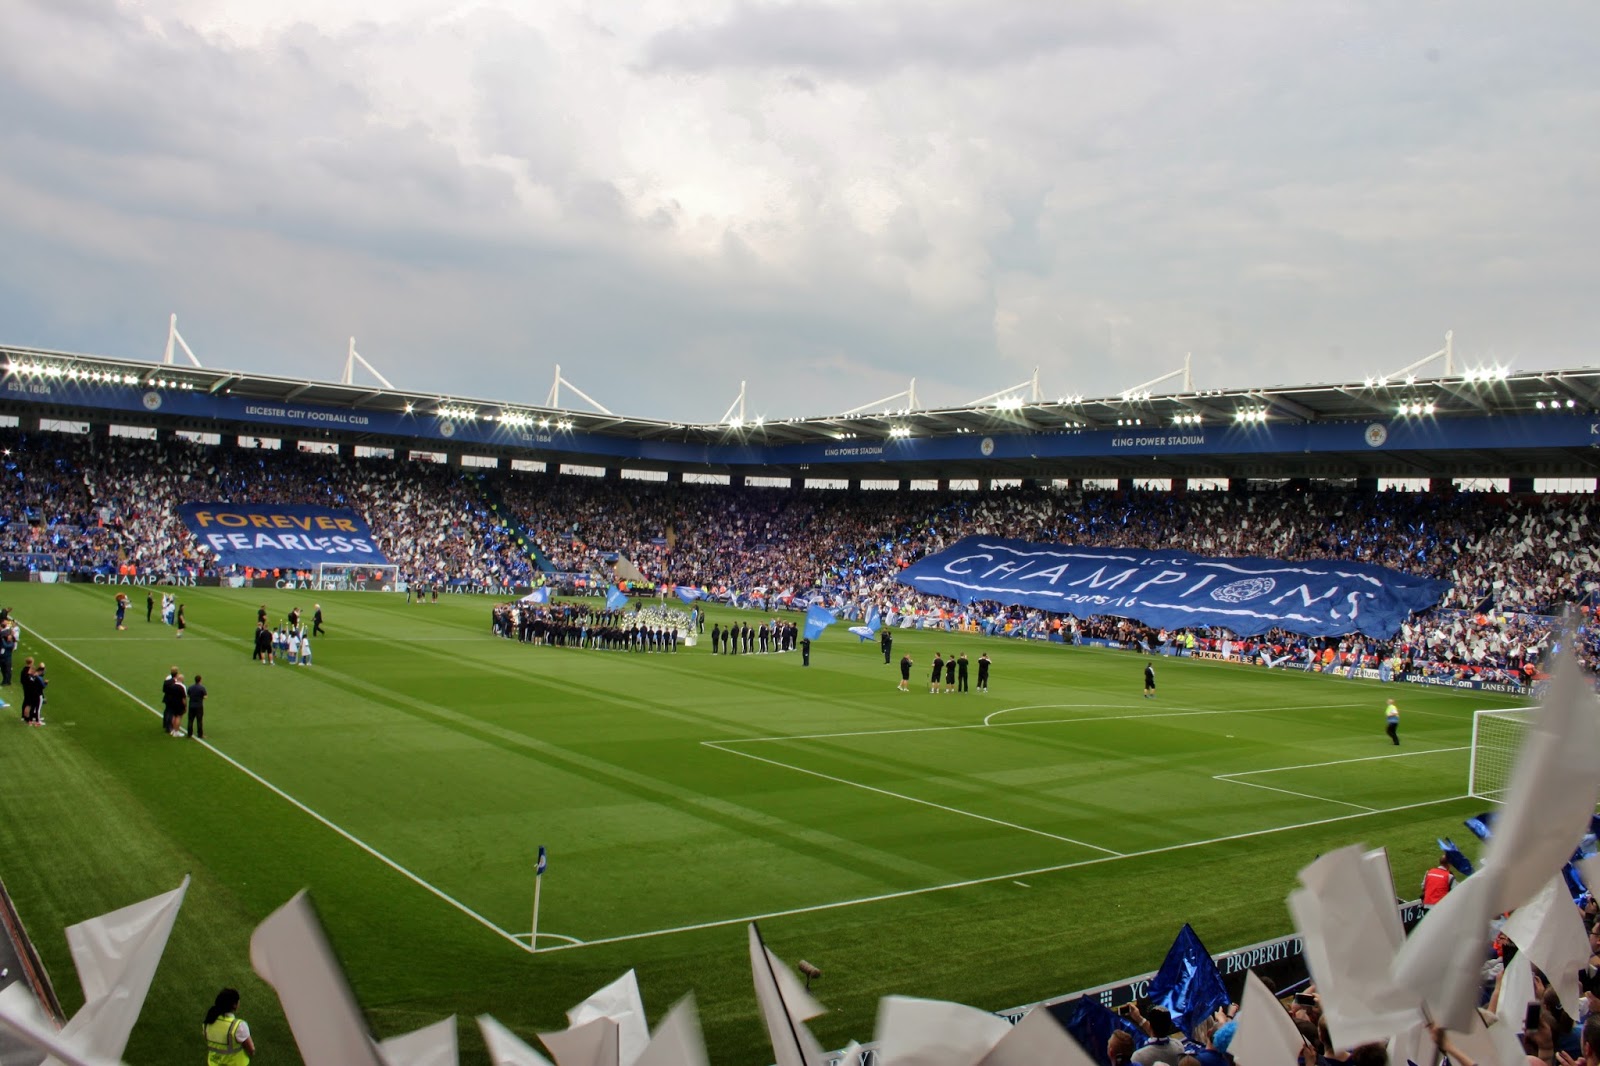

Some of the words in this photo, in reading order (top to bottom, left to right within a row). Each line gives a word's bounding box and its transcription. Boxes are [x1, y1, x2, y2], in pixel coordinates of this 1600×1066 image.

[29, 384, 51, 395] 1884
[245, 406, 286, 417] LEICESTER
[287, 410, 306, 419] CITY
[307, 411, 347, 423] FOOTBALL
[349, 415, 369, 425] CLUB
[1112, 438, 1134, 447] KING
[1135, 437, 1166, 446] POWER
[1167, 435, 1205, 446] STADIUM
[840, 448, 859, 456] POWER
[860, 447, 883, 455] STADIUM
[195, 511, 359, 533] FOREVER
[206, 532, 374, 555] FEARLESS
[1481, 682, 1506, 692] LANES
[1226, 940, 1290, 975] PROPERTY
